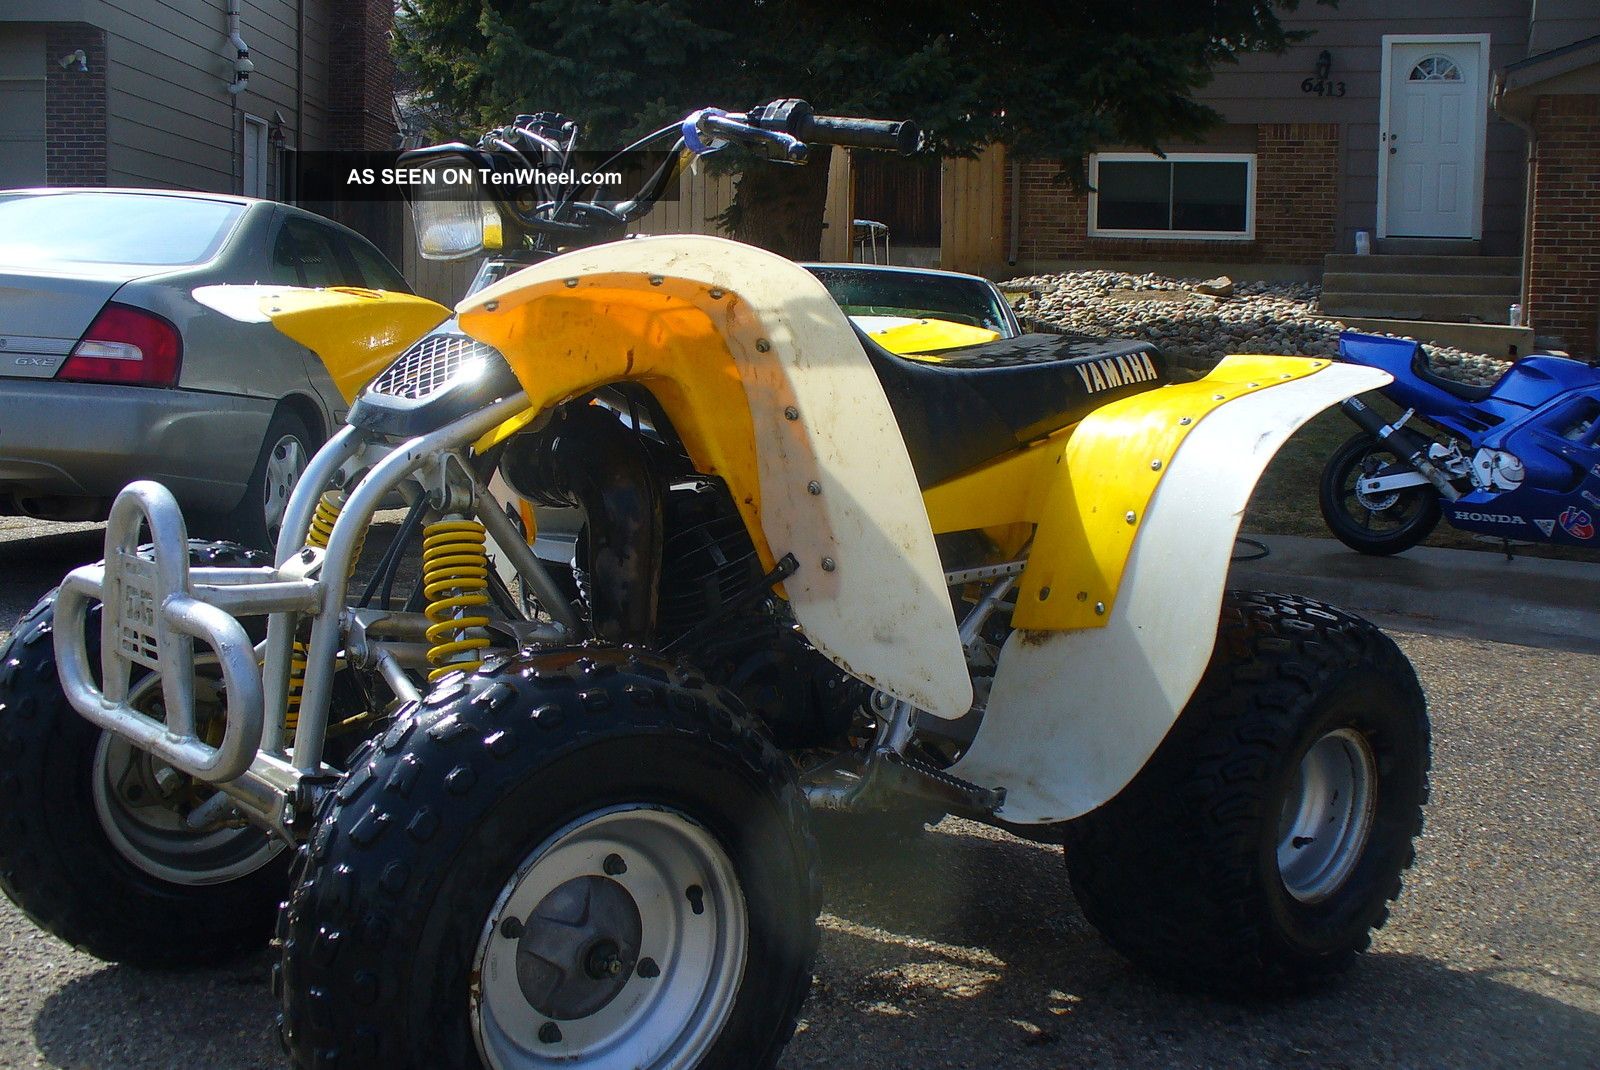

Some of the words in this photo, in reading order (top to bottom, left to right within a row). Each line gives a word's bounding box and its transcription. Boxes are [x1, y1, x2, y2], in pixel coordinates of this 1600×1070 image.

[1301, 77, 1346, 98] 6413
[15, 357, 56, 366] GXE
[1075, 351, 1158, 394] YAMAHA
[1454, 511, 1527, 525] HONDA
